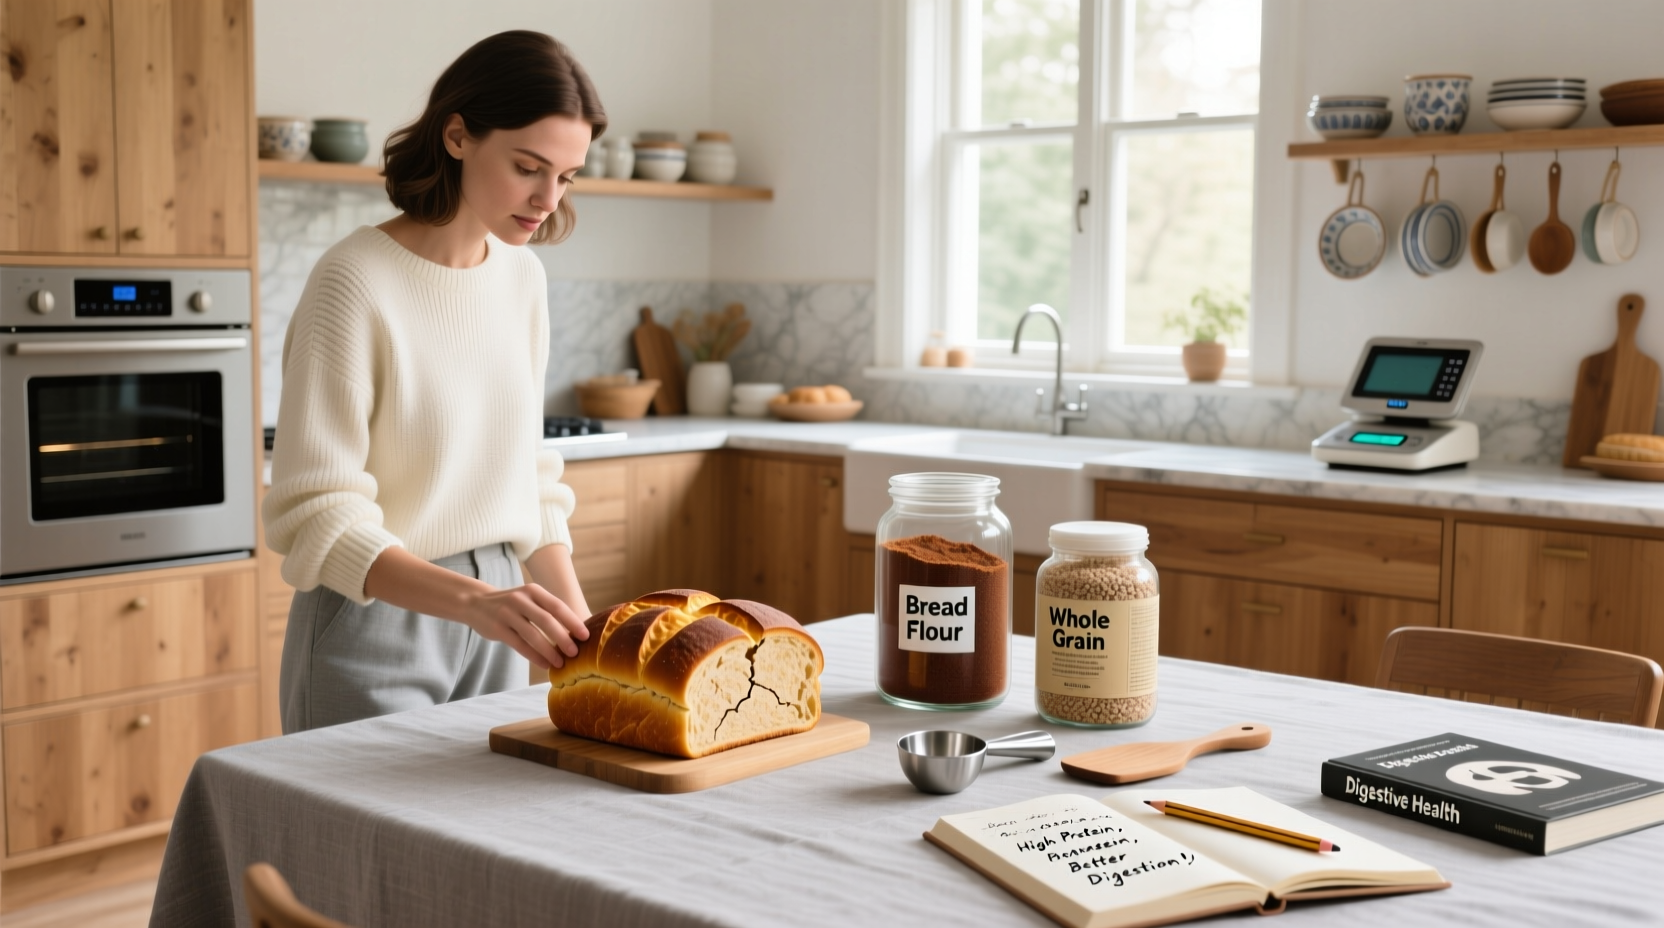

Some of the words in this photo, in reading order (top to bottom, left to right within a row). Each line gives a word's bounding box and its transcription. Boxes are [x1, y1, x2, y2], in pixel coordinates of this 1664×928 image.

[906, 595, 968, 616] Bread
[1049, 606, 1110, 629] Whole
[906, 620, 963, 641] Flour
[1052, 628, 1105, 650] Grain
[1345, 776, 1409, 809] Digestive
[1412, 795, 1460, 824] Health
[1016, 836, 1056, 852] High
[1068, 853, 1126, 873] Better
